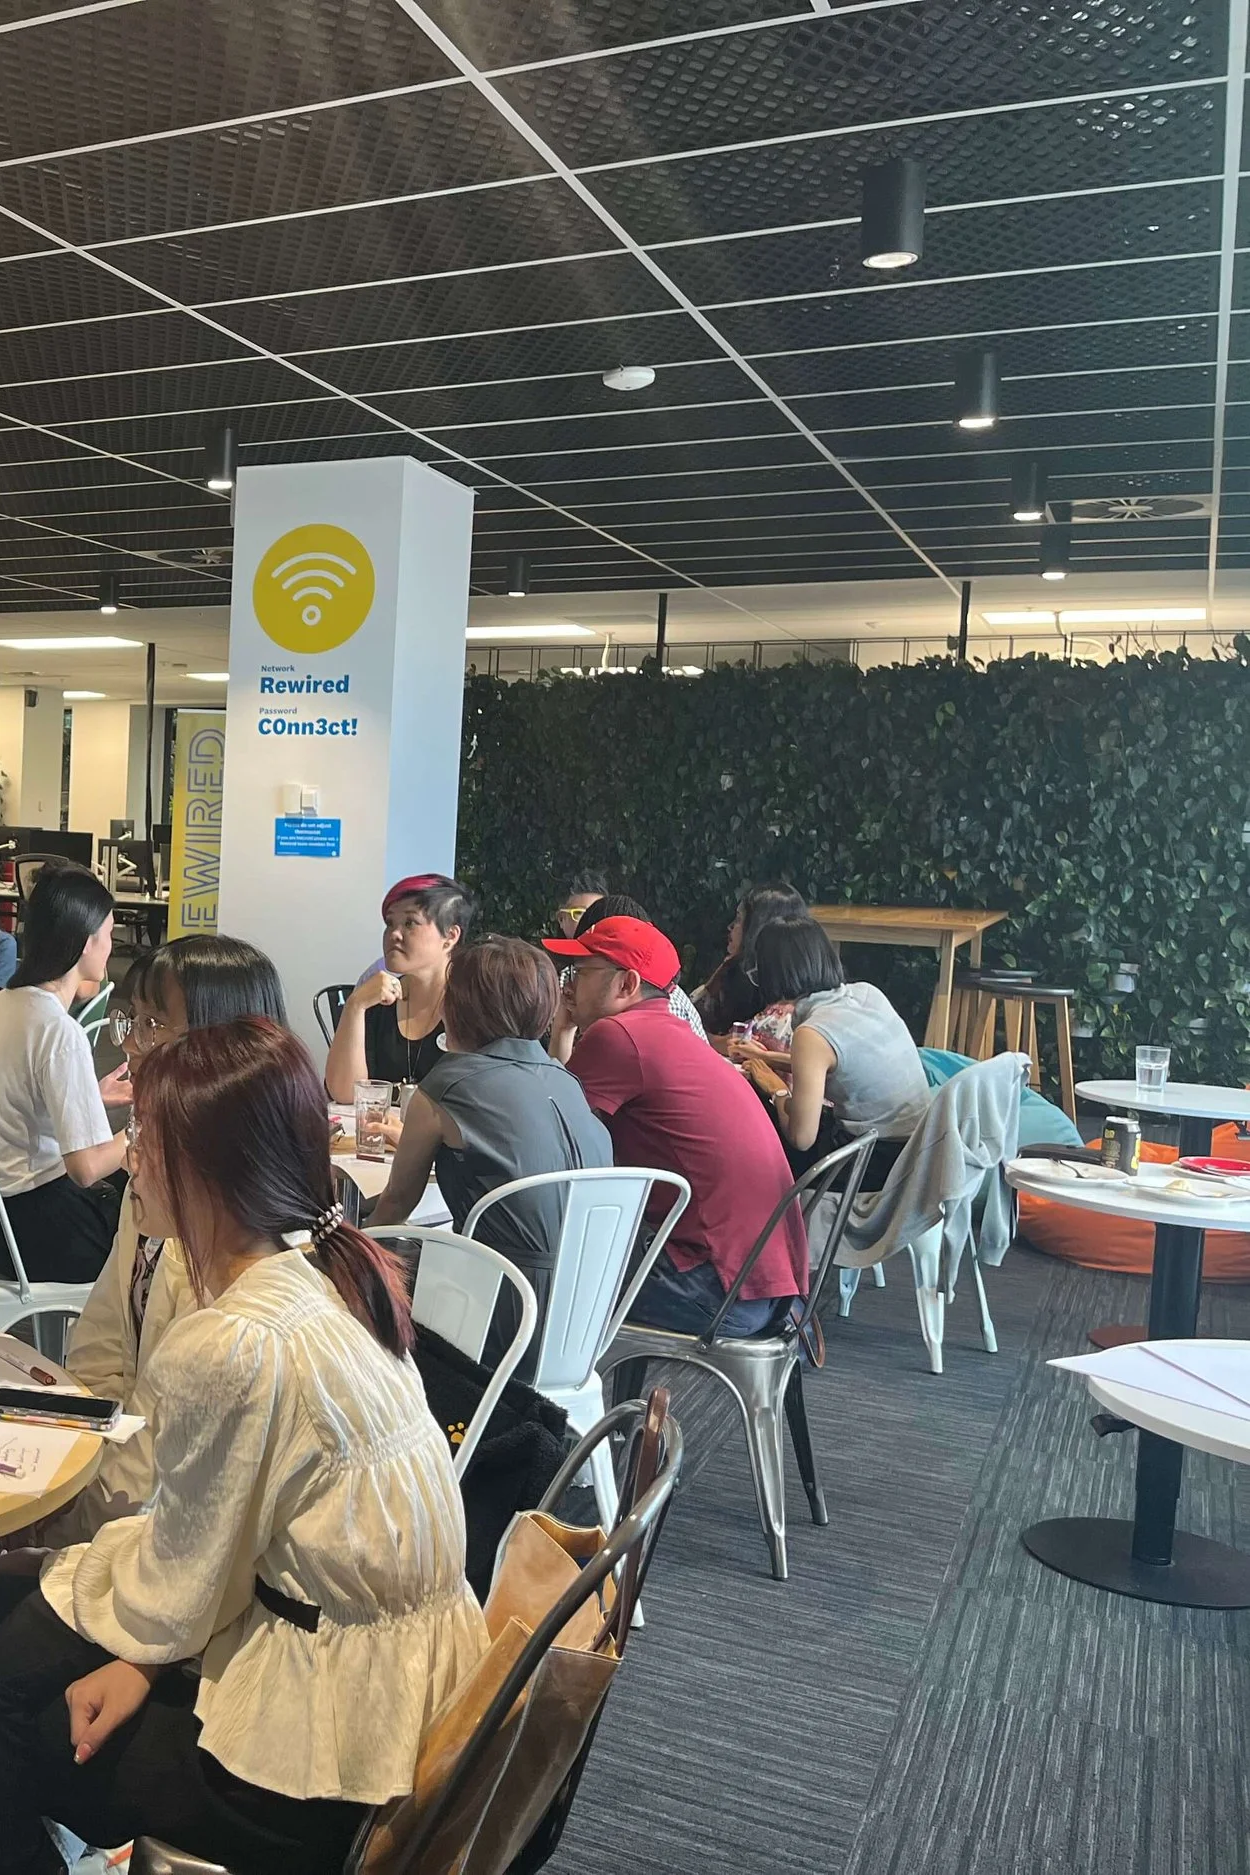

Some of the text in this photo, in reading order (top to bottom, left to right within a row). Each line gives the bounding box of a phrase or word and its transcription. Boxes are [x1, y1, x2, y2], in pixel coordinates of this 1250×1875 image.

[260, 674, 349, 694] Rewired
[259, 707, 297, 715] Password
[181, 728, 225, 928] EWIRED
